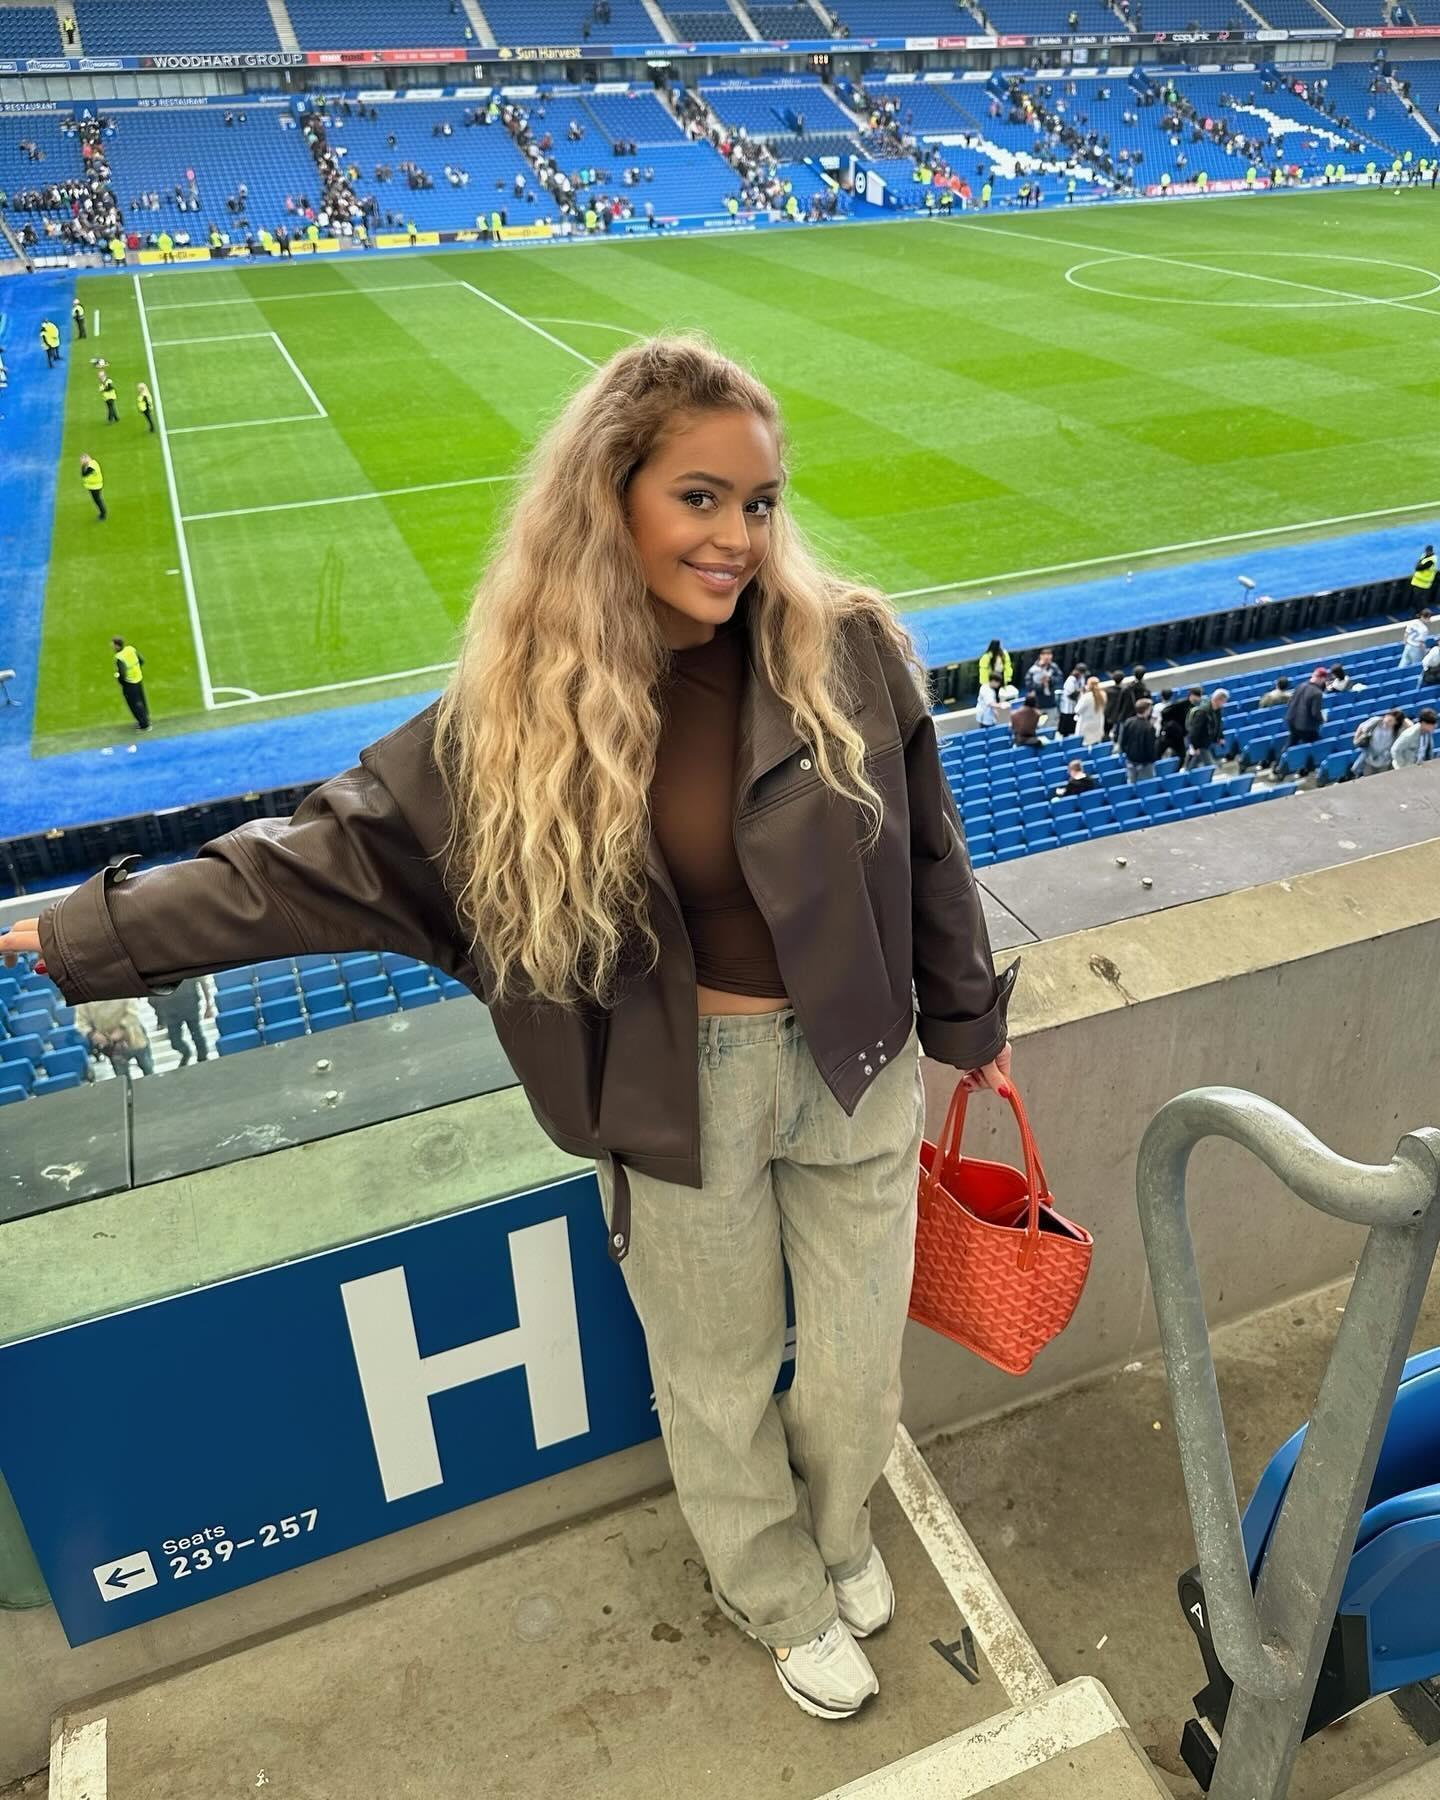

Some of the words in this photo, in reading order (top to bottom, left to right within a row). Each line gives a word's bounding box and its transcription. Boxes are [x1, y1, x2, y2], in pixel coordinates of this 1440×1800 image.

[152, 55, 241, 68] WOODHART
[244, 54, 304, 66] GROUP
[515, 47, 538, 59] Sun
[539, 46, 583, 58] Harvest
[340, 1215, 590, 1503] H
[161, 1524, 227, 1556] Seats
[929, 1625, 981, 1685] A
